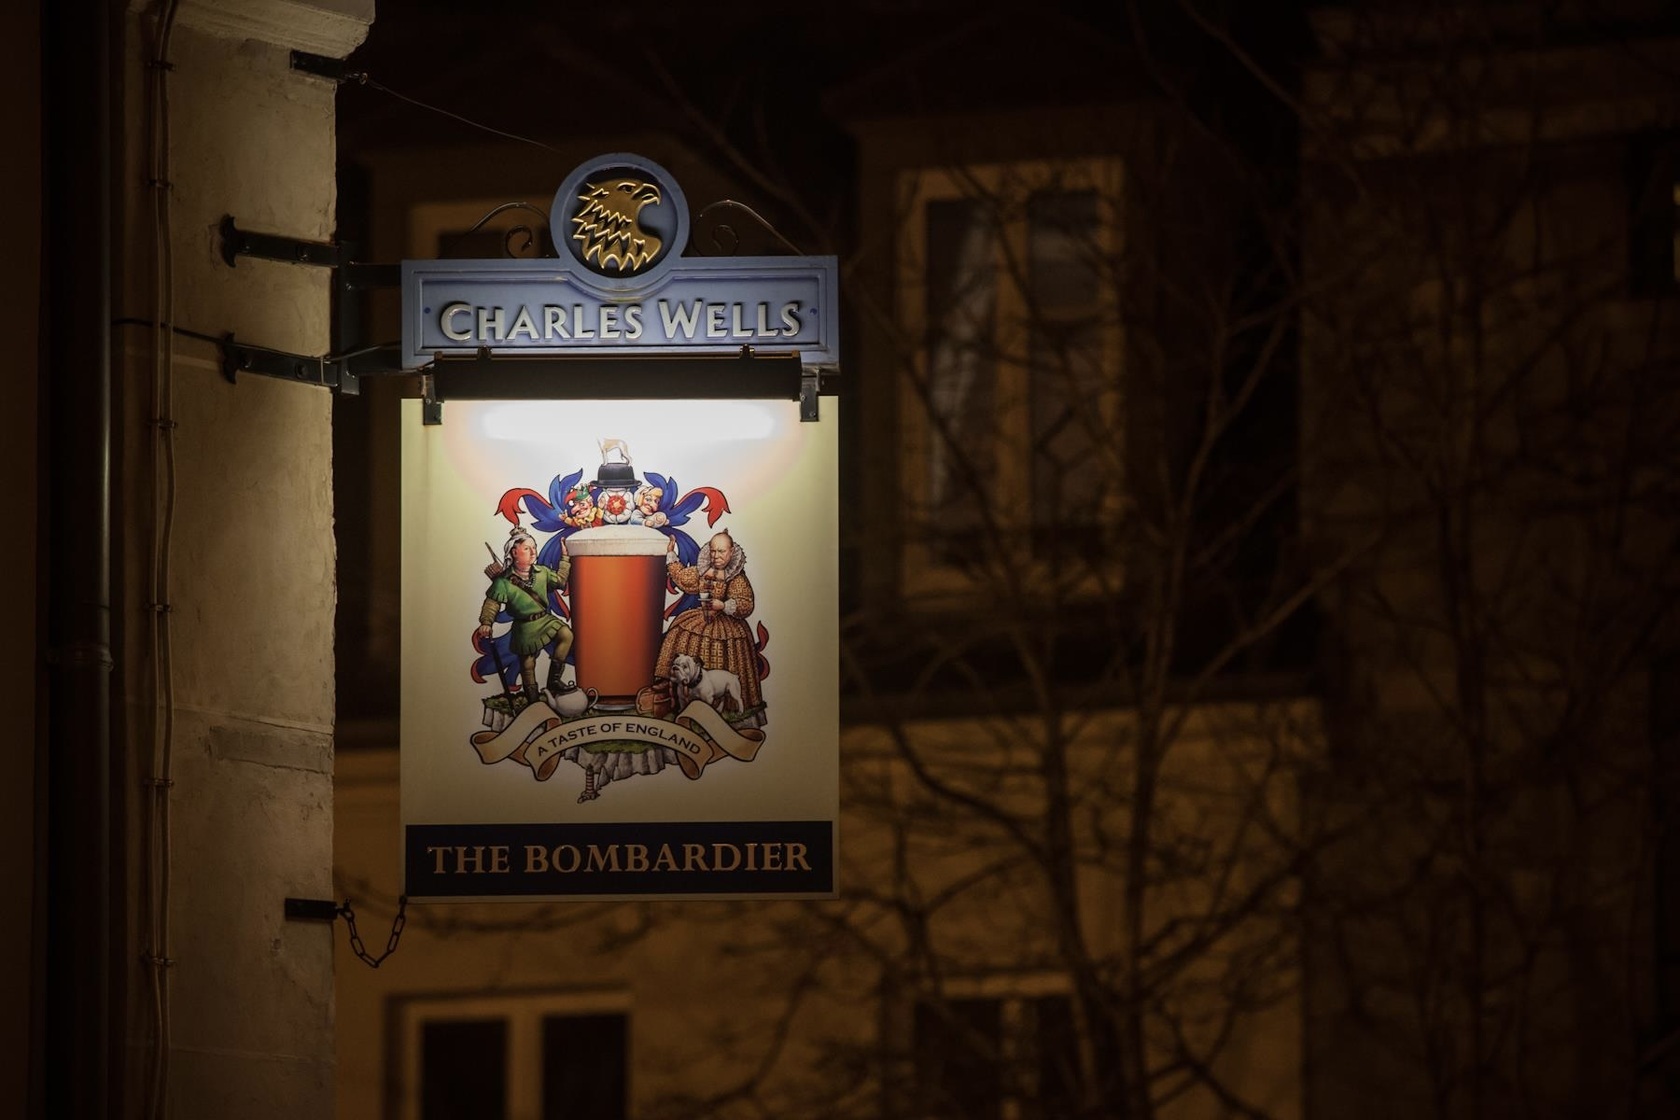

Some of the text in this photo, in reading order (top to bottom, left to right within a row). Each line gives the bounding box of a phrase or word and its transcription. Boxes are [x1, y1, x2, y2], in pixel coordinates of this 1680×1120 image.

[439, 300, 801, 342] CHARLES WELLS
[538, 722, 701, 757] A TASTE OF ENGLAND
[427, 843, 812, 875] THE BOMBARDIER
